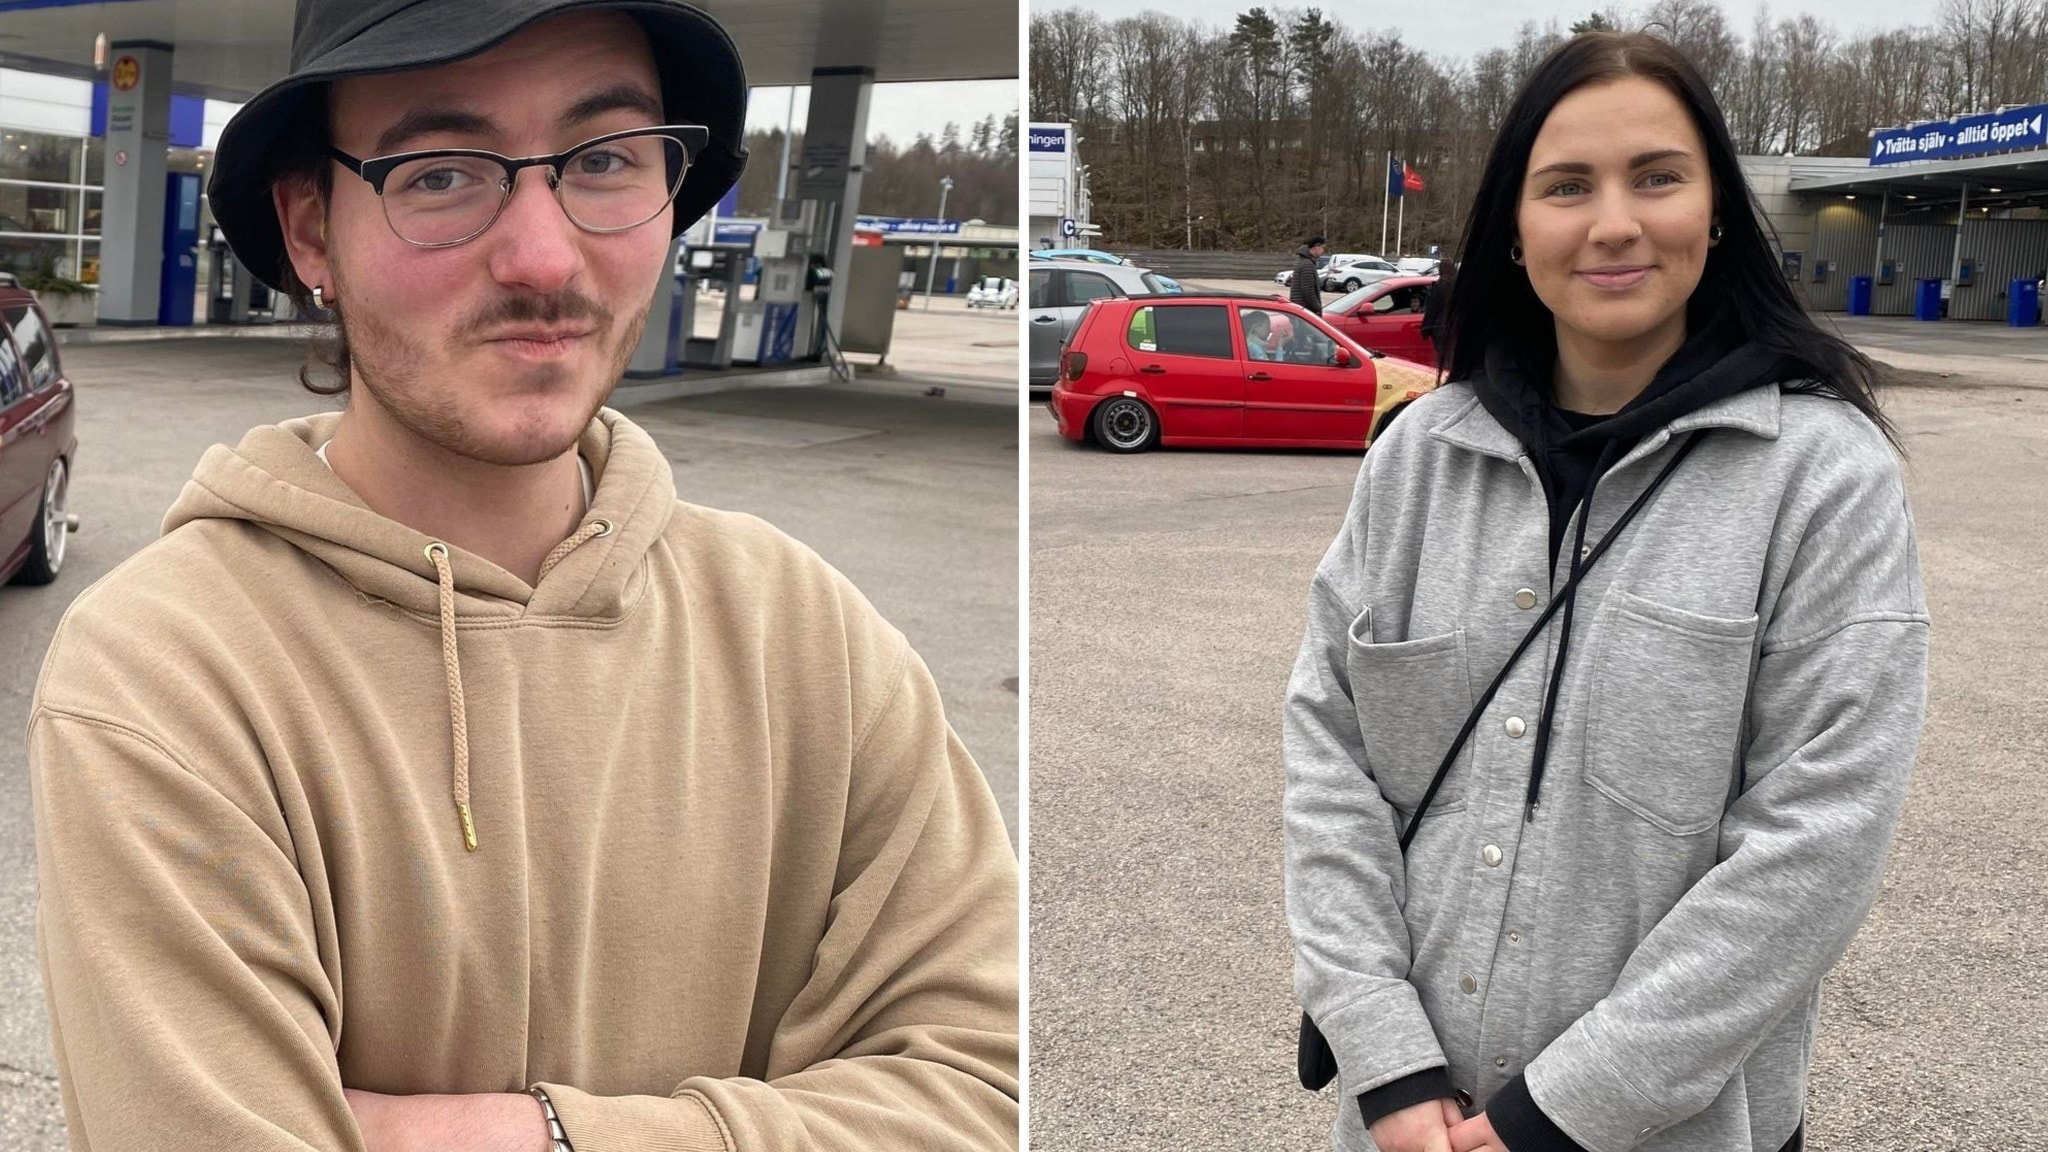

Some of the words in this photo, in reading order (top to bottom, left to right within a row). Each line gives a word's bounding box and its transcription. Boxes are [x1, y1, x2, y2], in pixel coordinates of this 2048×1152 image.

[1886, 138, 1917, 154] Tvätta
[1918, 132, 1946, 153] själv
[1957, 124, 1989, 145] alltid
[1991, 118, 2029, 142] öppet
[1064, 221, 1074, 236] C
